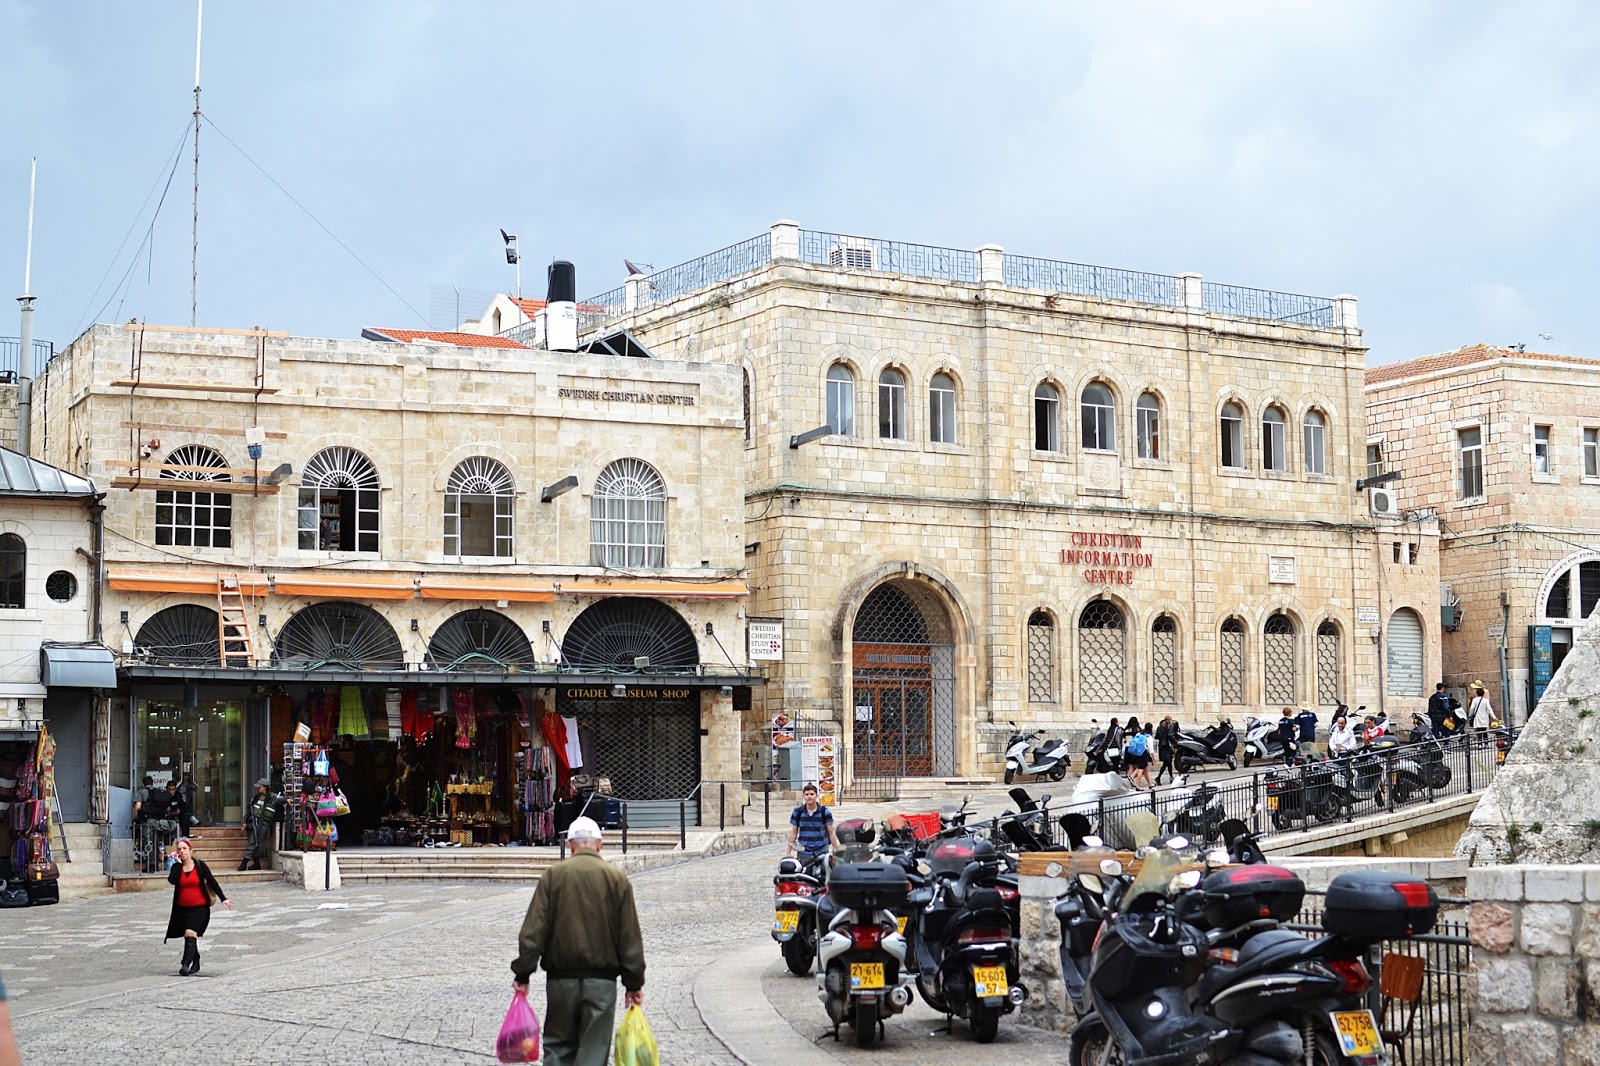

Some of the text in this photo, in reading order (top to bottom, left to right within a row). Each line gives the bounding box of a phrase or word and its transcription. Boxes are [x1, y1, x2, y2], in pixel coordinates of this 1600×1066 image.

[558, 388, 695, 406] SWEDISH CHRISTIAN CENTER
[1071, 532, 1142, 549] CHRISTIAN
[1061, 549, 1153, 567] INFORMATION
[1084, 569, 1133, 584] CENTRE
[567, 688, 690, 698] CITADEL USEUM SHOP
[862, 976, 873, 985] 74
[986, 983, 997, 994] 57
[1337, 1016, 1373, 1031] 52-758
[1355, 1033, 1369, 1047] 63
